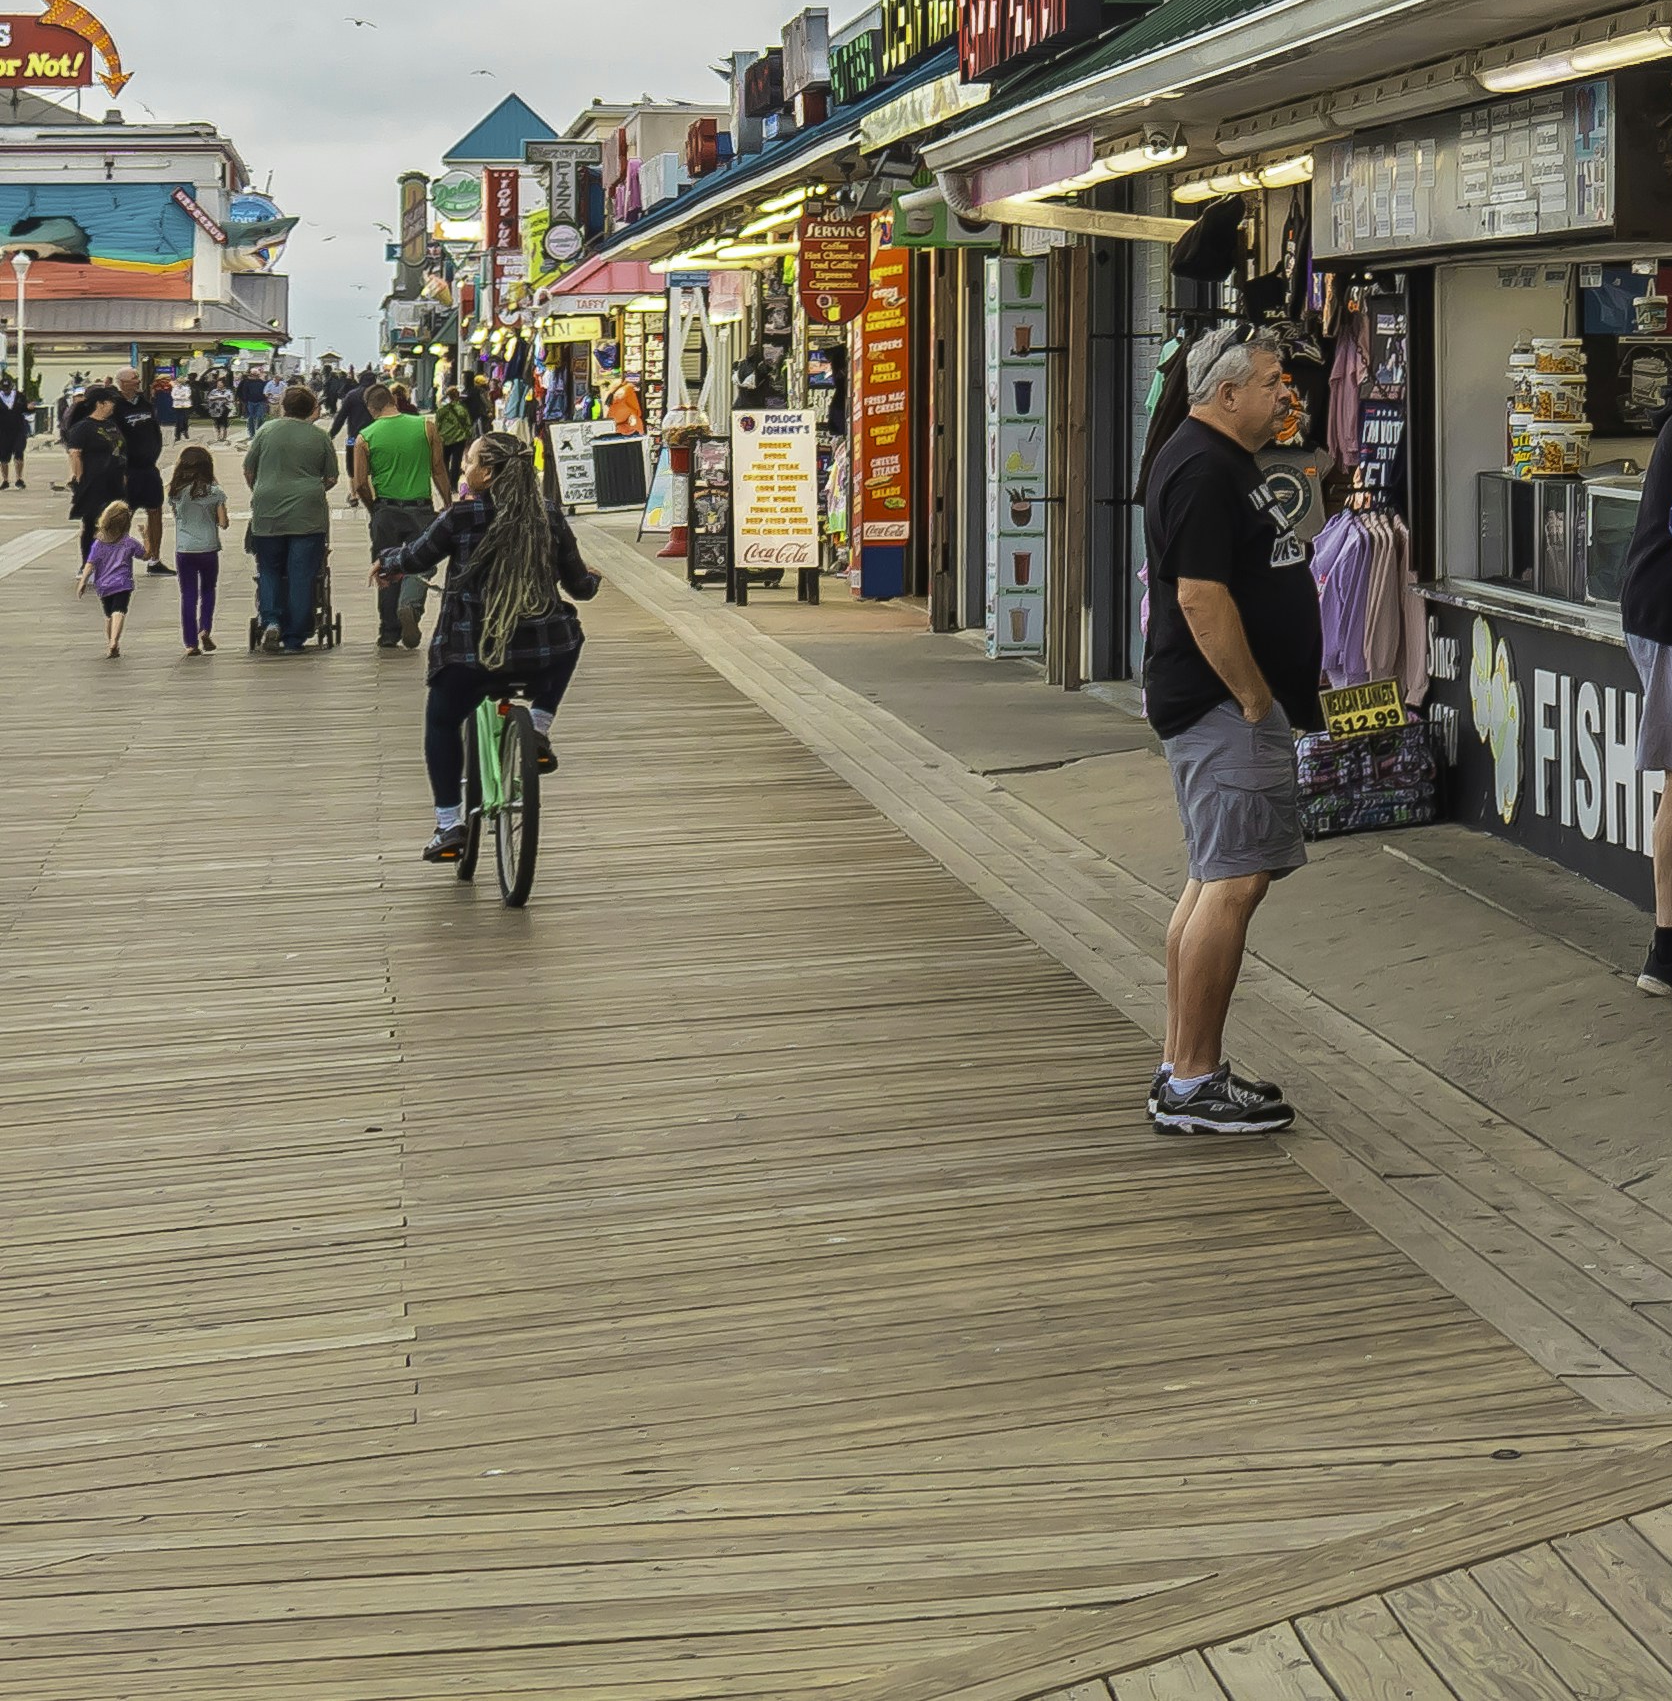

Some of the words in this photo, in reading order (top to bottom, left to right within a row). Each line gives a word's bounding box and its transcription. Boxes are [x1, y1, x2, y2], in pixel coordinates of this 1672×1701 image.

[24, 52, 84, 77] Not!
[556, 161, 571, 221] PIZZA
[805, 223, 865, 237] SERVING
[576, 300, 606, 309] TAFFY
[765, 415, 802, 424] POLOCK
[761, 425, 810, 435] JOHNNY'S
[1427, 615, 1460, 681] Since
[1332, 709, 1400, 737] $12.99
